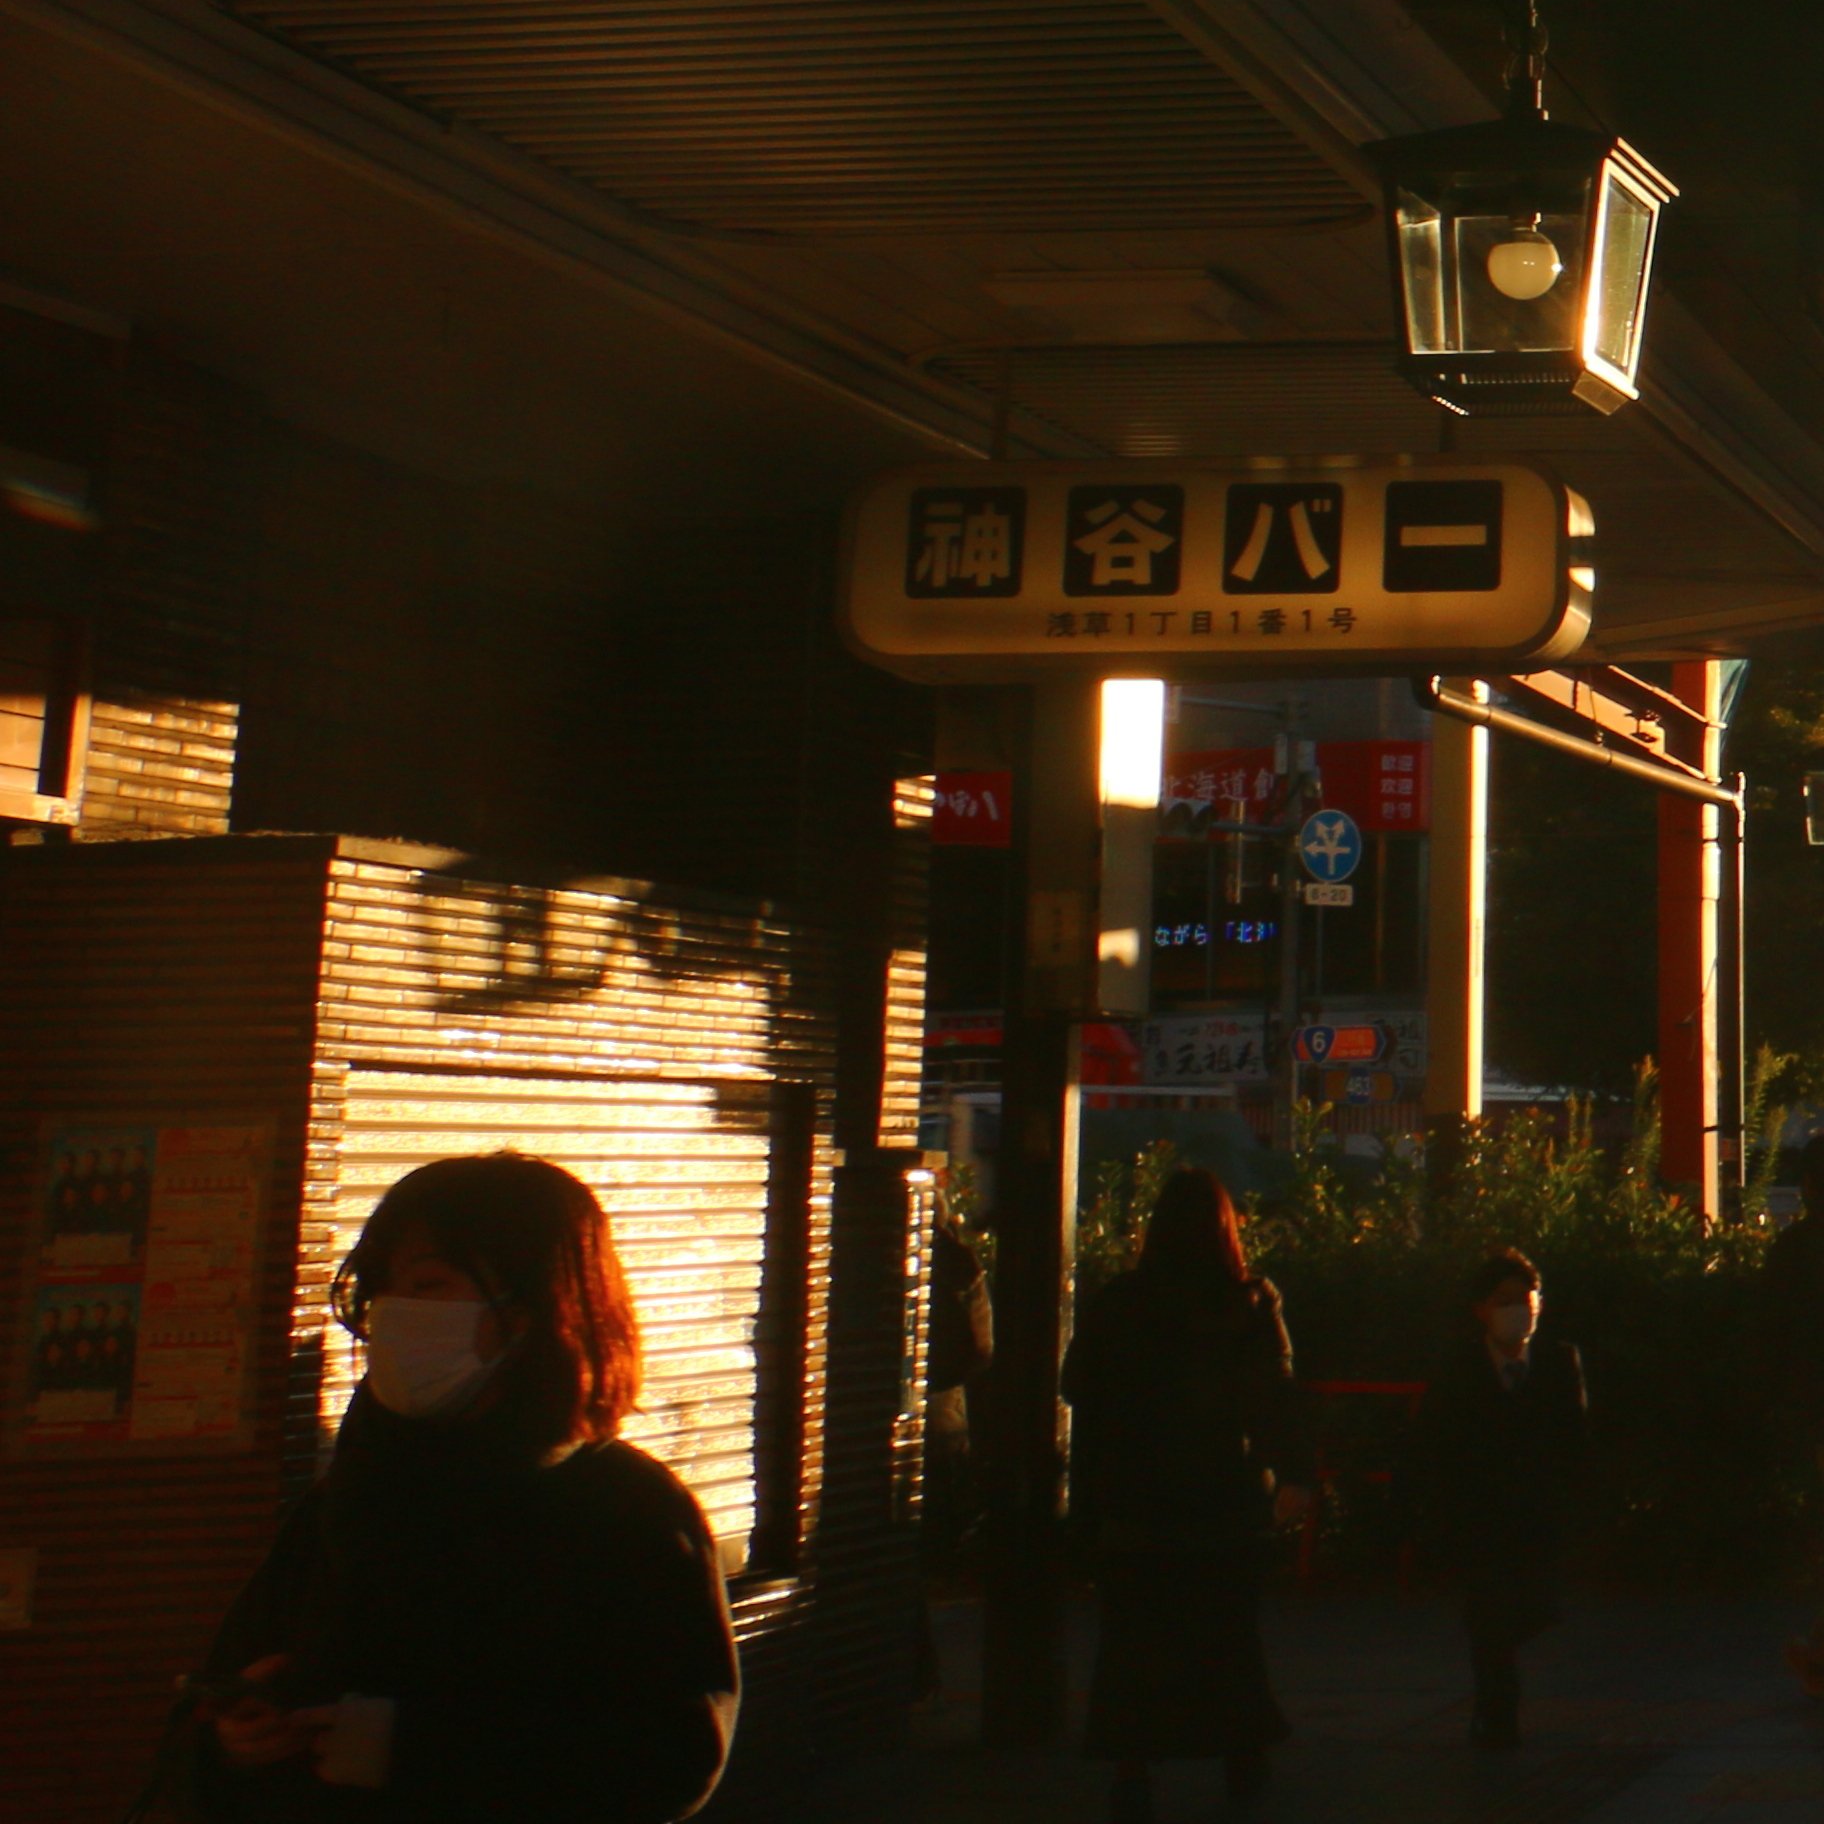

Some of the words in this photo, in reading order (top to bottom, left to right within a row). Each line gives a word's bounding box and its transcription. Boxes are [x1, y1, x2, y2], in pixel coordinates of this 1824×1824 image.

[914, 497, 1489, 589] 神谷バー
[1045, 607, 1358, 638] 浅草1丁目1番1号
[1311, 1031, 1326, 1054] 6
